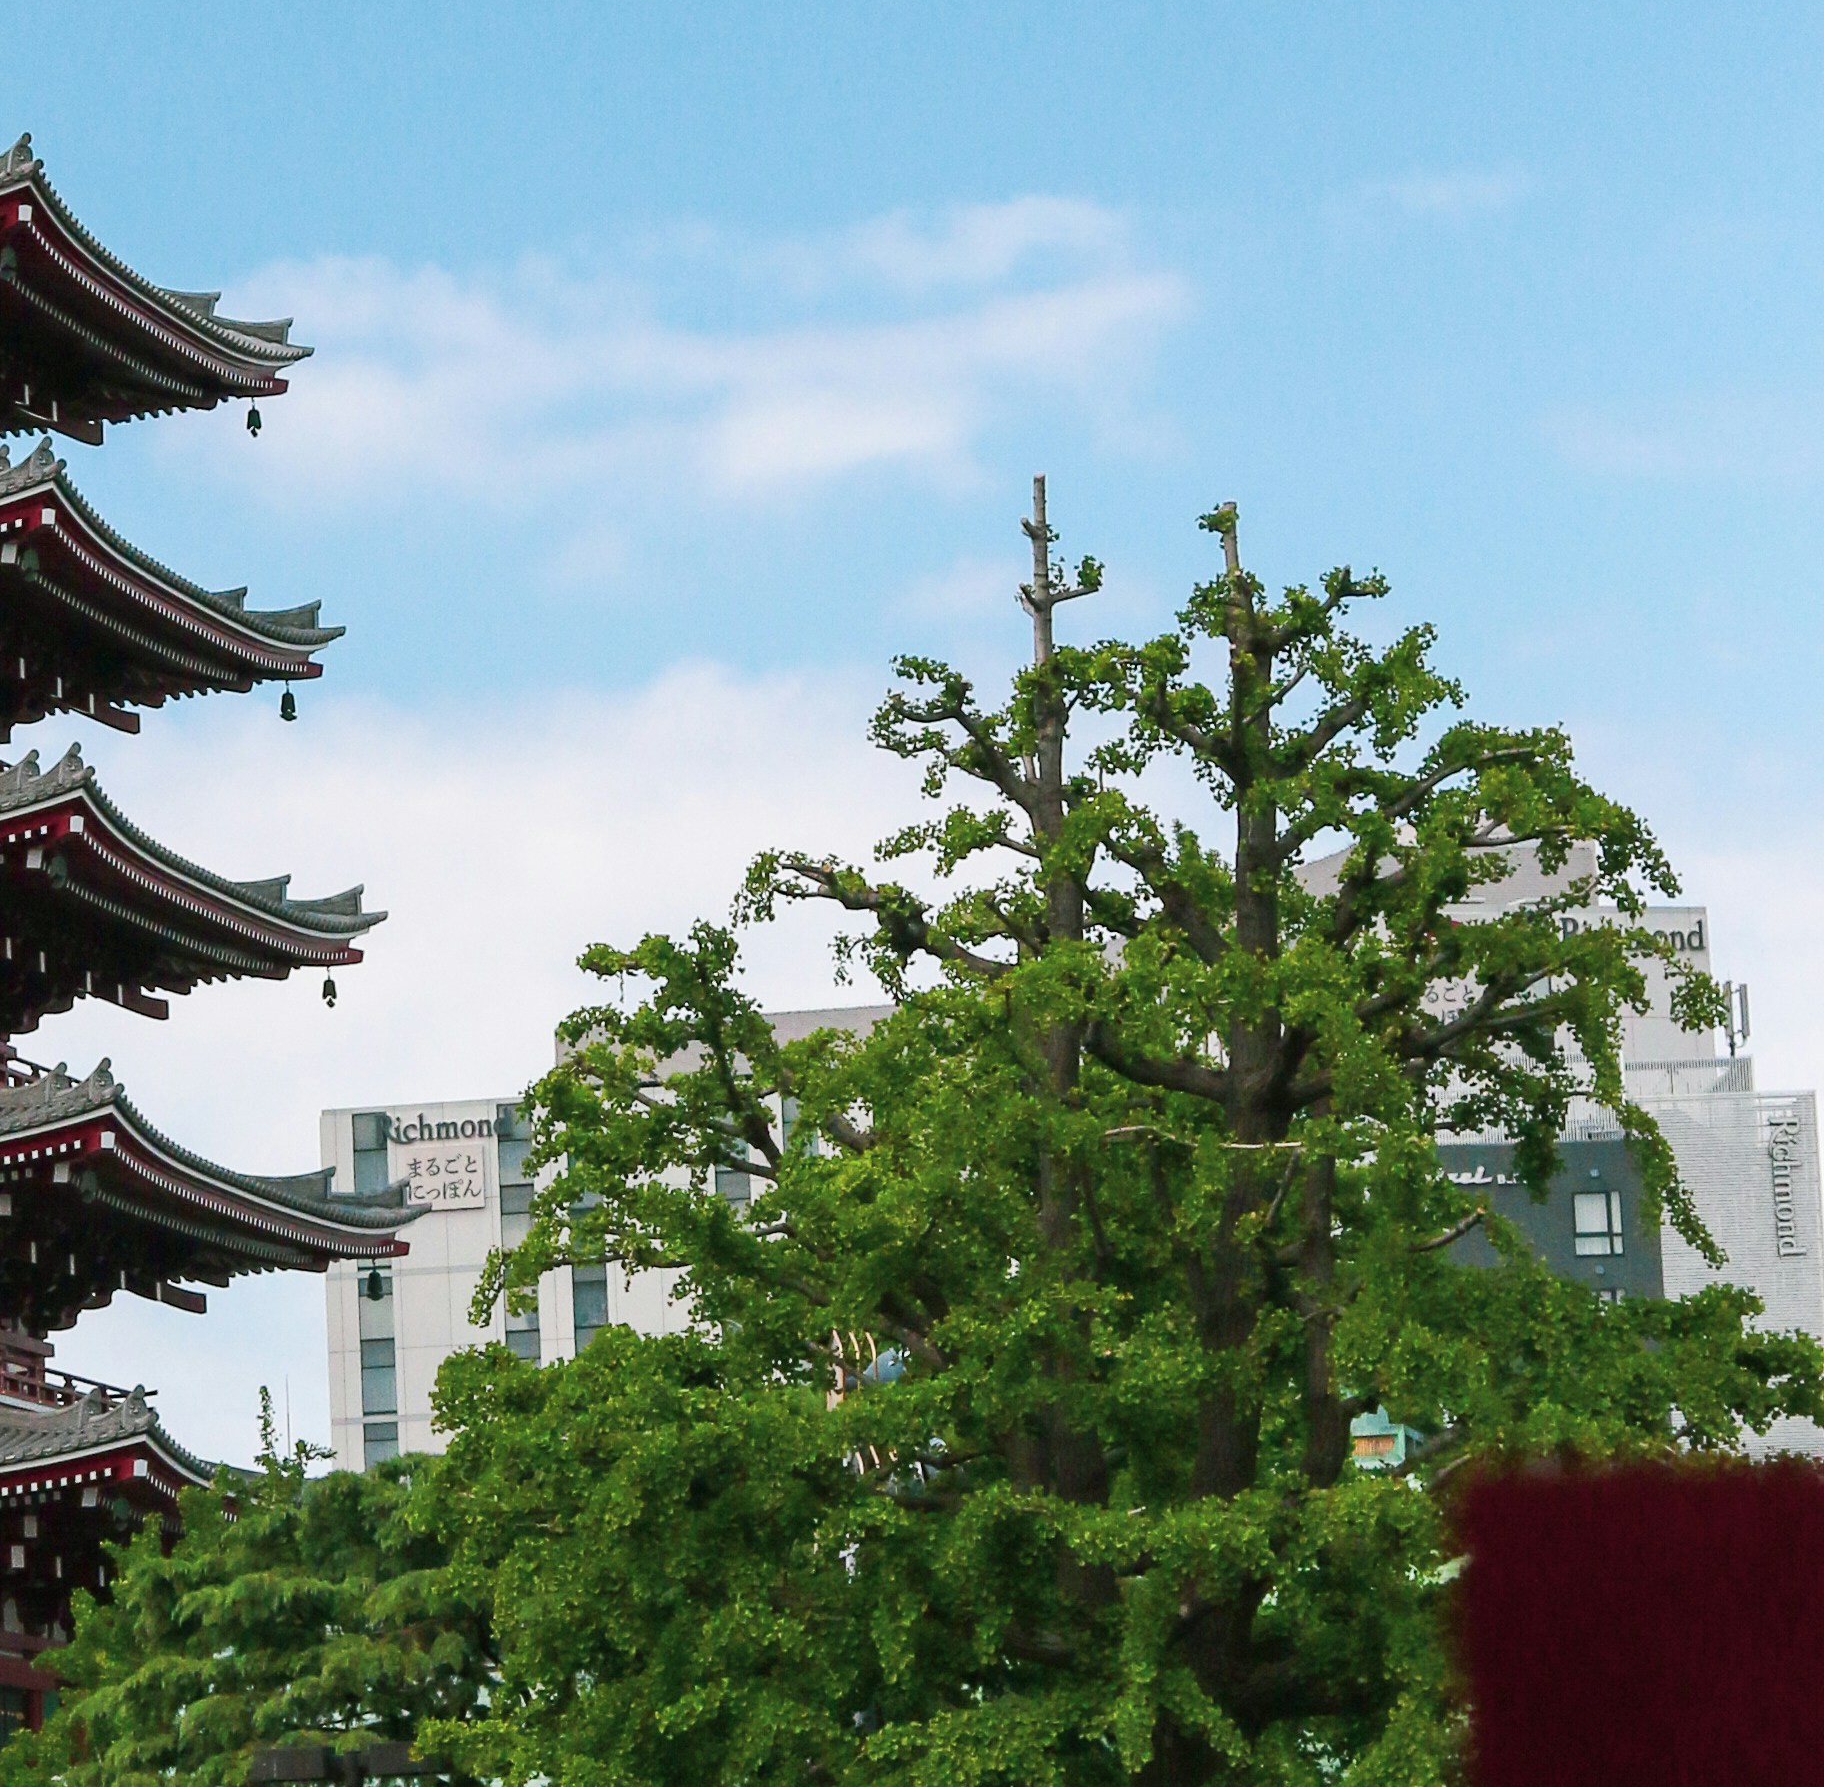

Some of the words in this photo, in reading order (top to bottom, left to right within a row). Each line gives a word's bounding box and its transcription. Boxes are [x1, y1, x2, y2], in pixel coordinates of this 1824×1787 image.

[379, 1107, 514, 1145] Richmond
[407, 1153, 478, 1179] まるごと
[408, 1179, 482, 1200] にっぽん
[1768, 1116, 1807, 1259] Richmond
